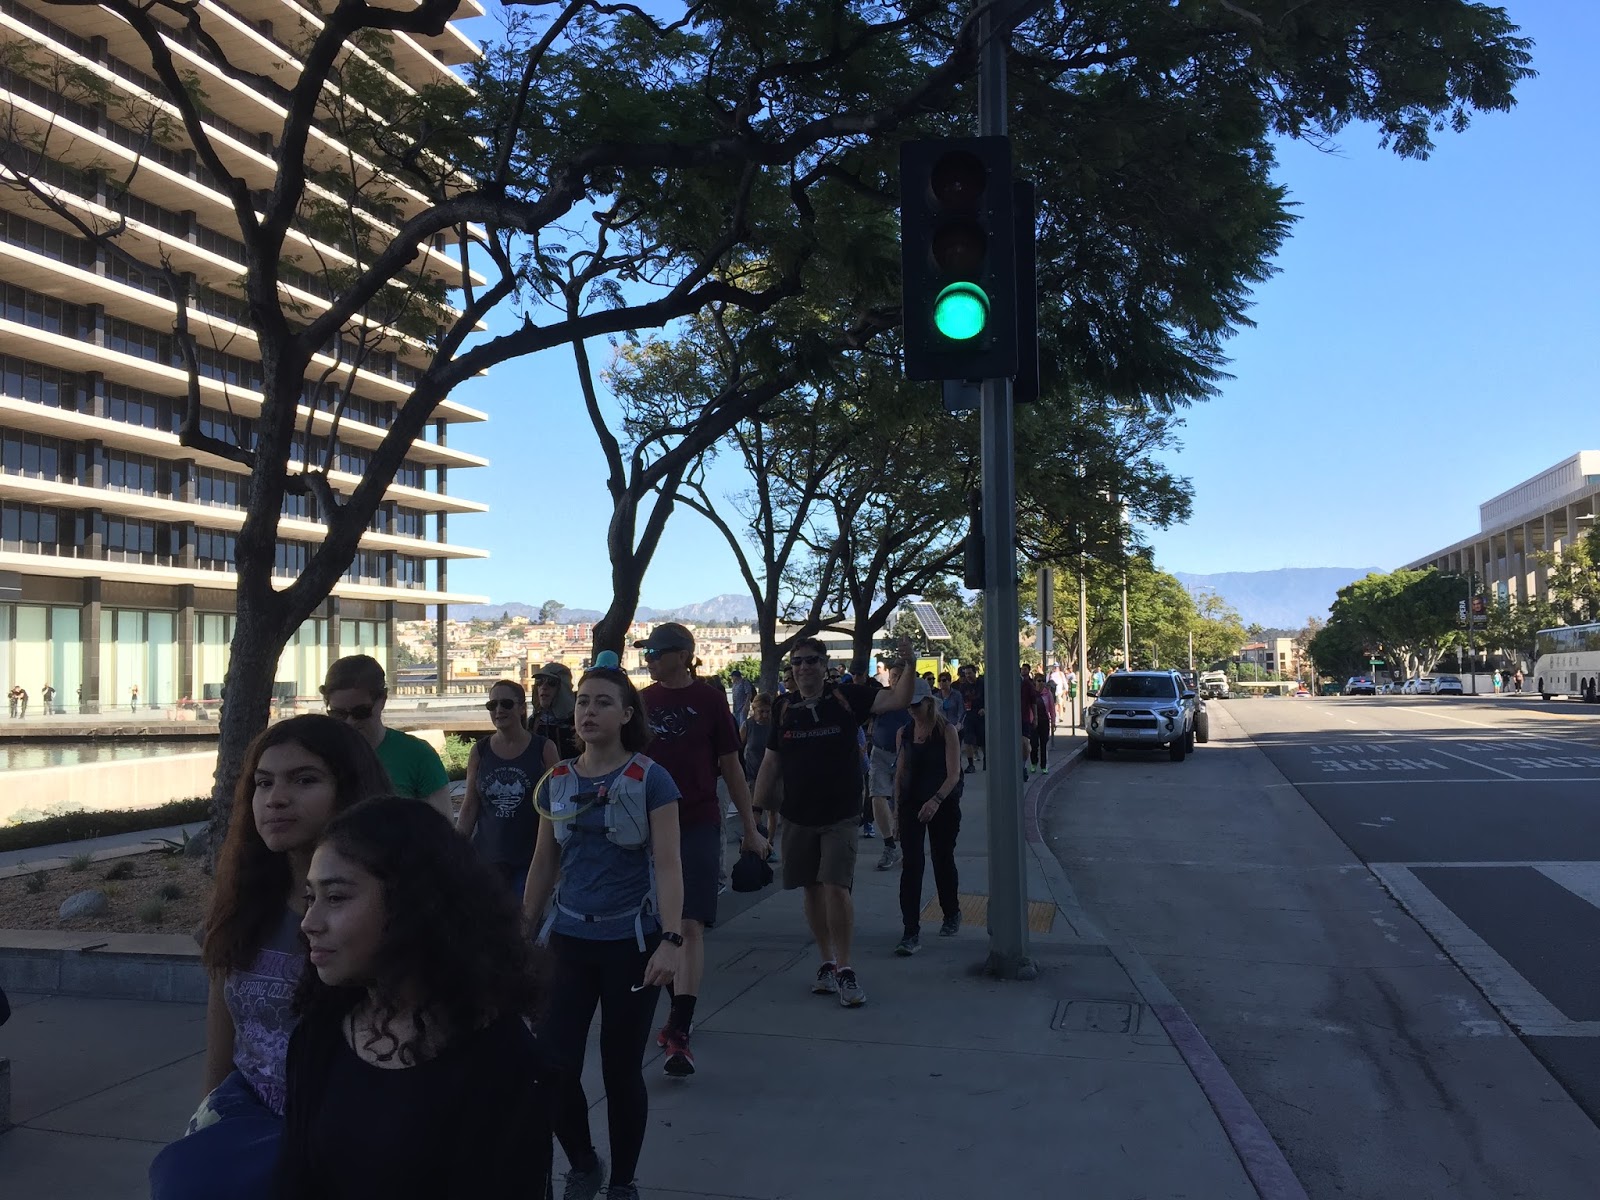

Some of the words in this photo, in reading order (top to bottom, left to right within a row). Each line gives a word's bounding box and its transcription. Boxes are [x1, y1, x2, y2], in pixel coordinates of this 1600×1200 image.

[1459, 600, 1467, 620] OPERA
[1310, 744, 1401, 754] WAIT
[1312, 758, 1450, 771] HERE
[1492, 757, 1600, 769] ERE
[238, 981, 268, 996] SPRING
